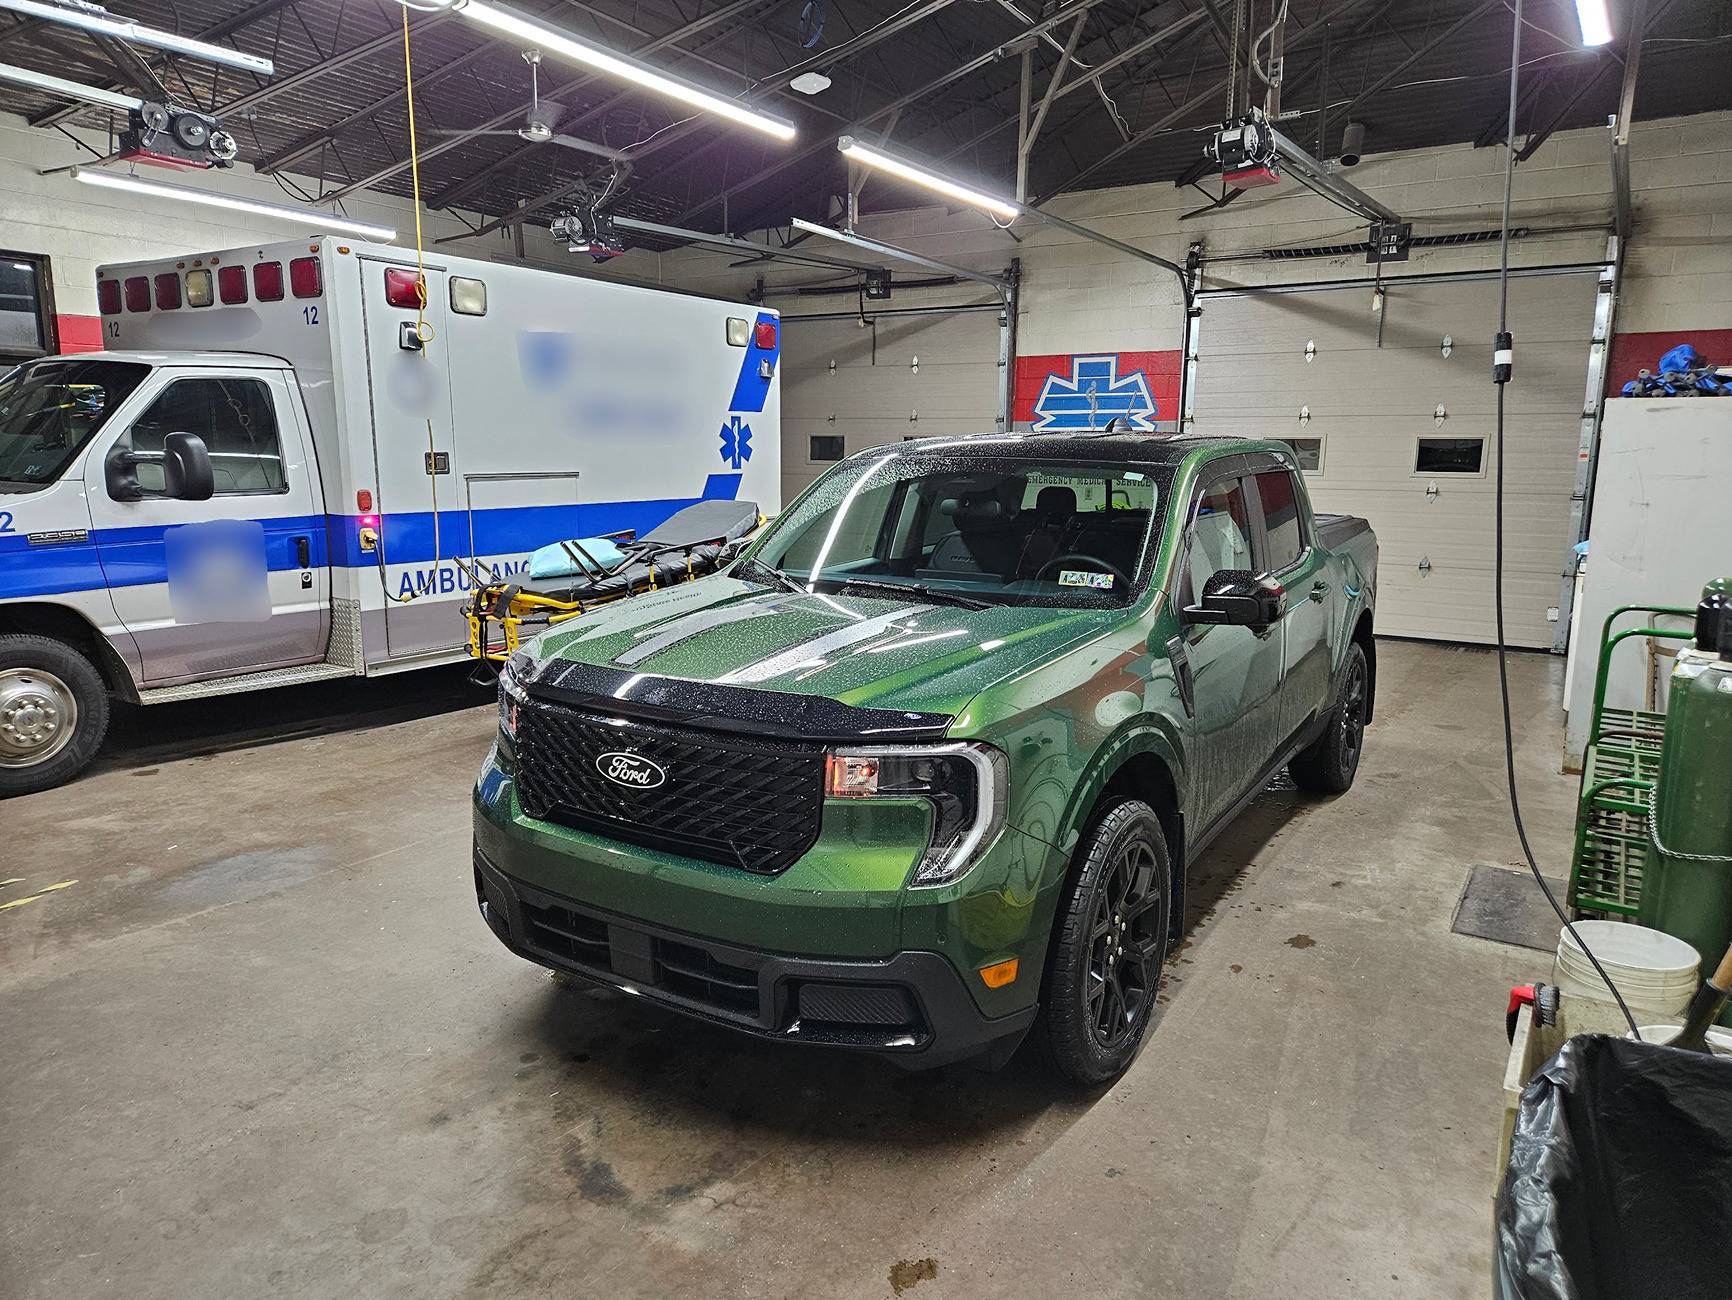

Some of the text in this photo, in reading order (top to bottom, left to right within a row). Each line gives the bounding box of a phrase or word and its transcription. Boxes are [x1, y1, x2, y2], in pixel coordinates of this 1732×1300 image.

[303, 306, 319, 325] 12
[108, 321, 120, 337] 12
[1028, 475, 1072, 486] EMERGENCY
[1077, 478, 1107, 486] MEDICA
[399, 560, 530, 598] AMBULAN
[608, 756, 651, 784] Ford
